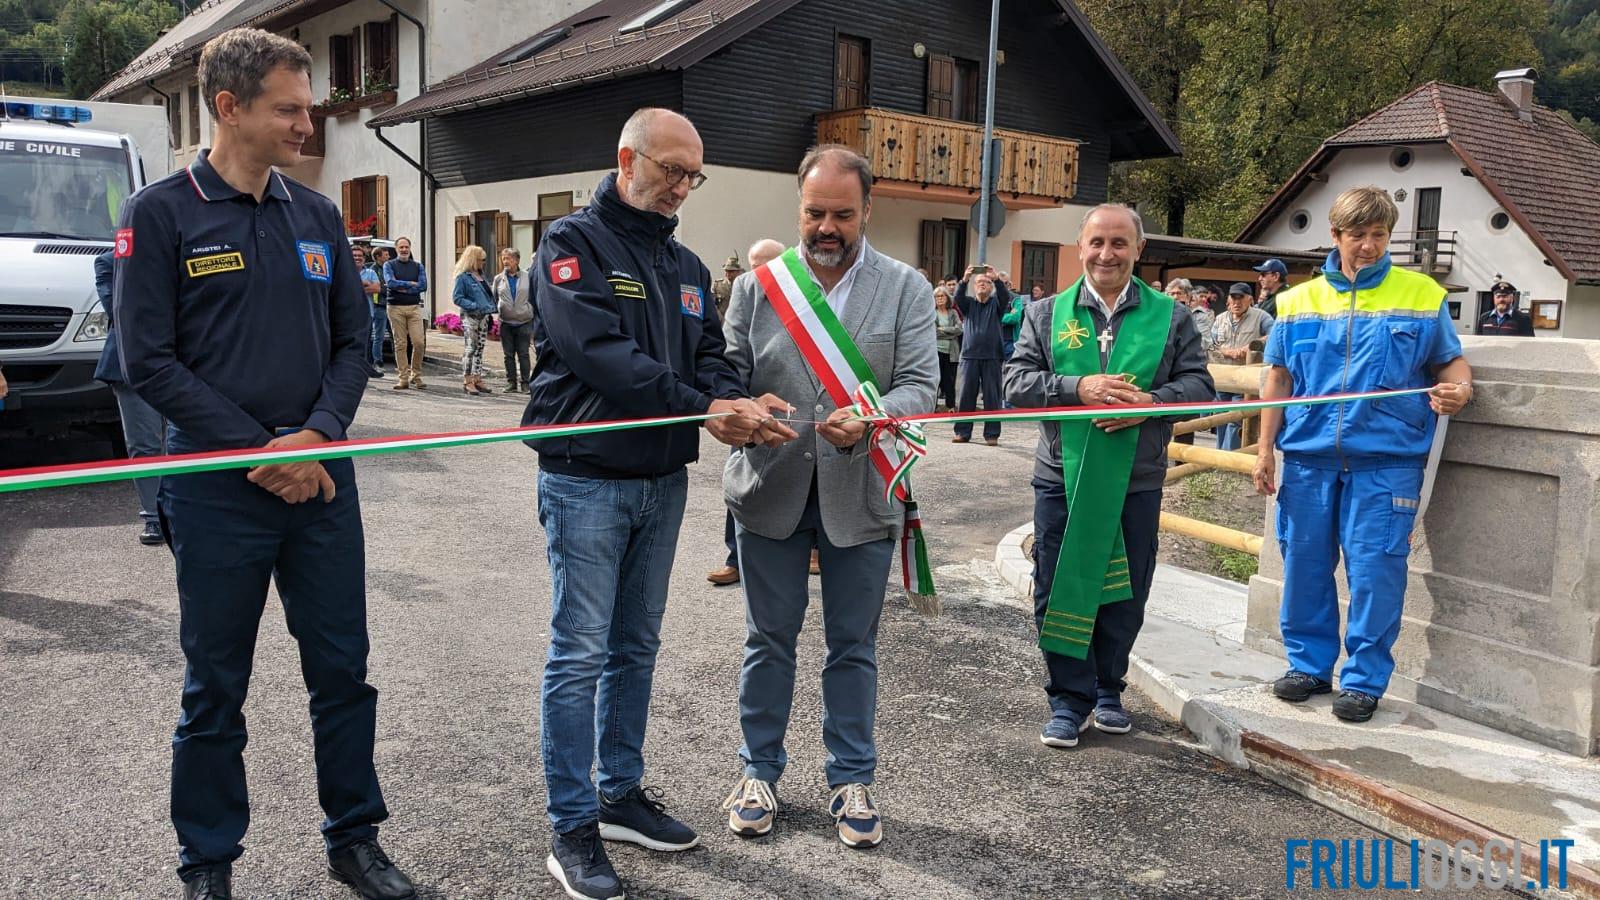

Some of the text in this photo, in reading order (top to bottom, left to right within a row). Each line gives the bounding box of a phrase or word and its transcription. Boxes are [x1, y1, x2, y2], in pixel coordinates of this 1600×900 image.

[26, 143, 81, 158] CIVILE
[192, 245, 221, 253] ARISTEI
[194, 255, 237, 267] DIRETTORE
[196, 261, 239, 273] REGIONALE
